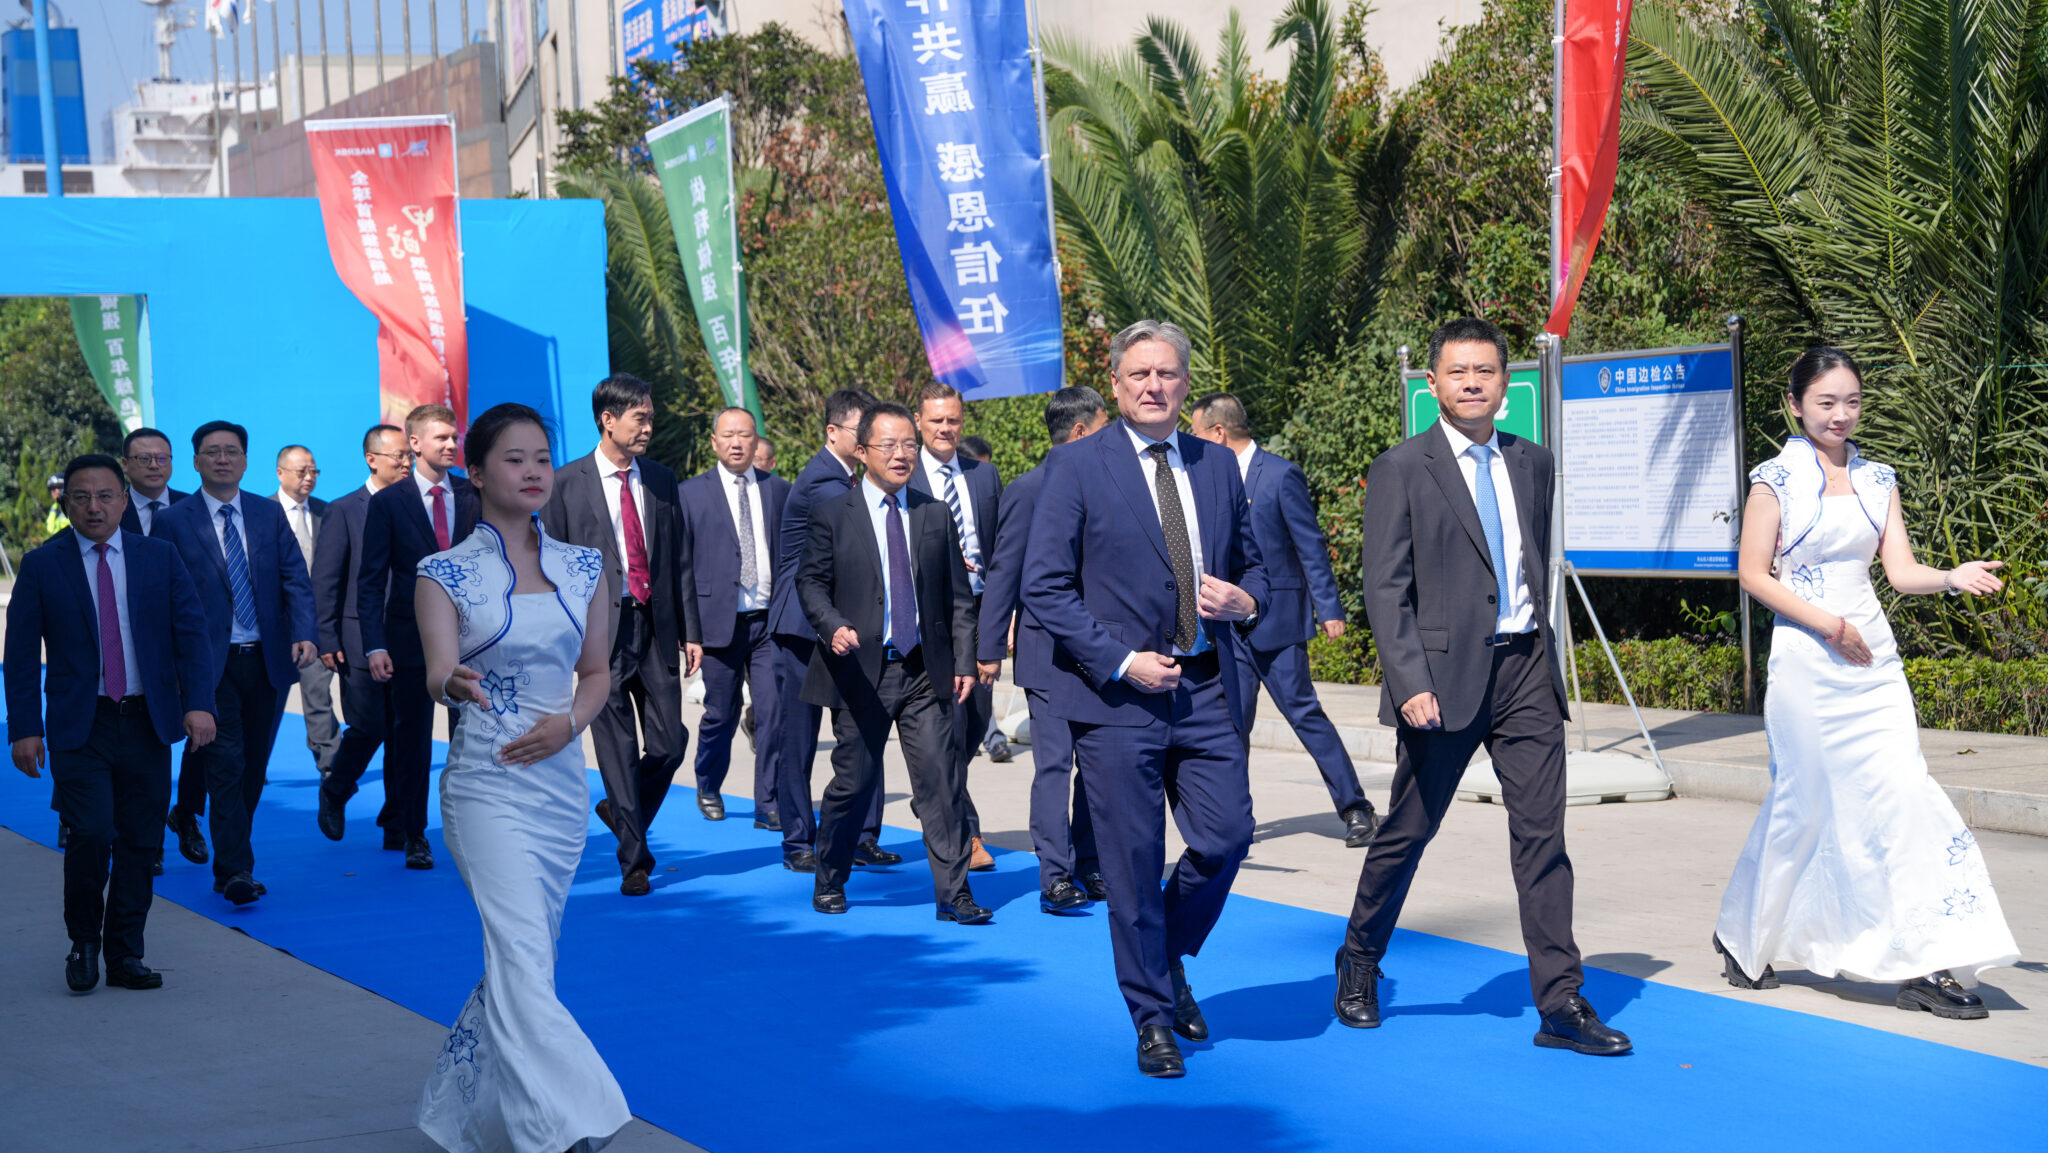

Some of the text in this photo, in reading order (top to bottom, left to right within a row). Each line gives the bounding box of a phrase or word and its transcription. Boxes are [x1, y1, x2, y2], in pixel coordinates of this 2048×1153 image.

[1615, 363, 1685, 385] 中国边检公告
